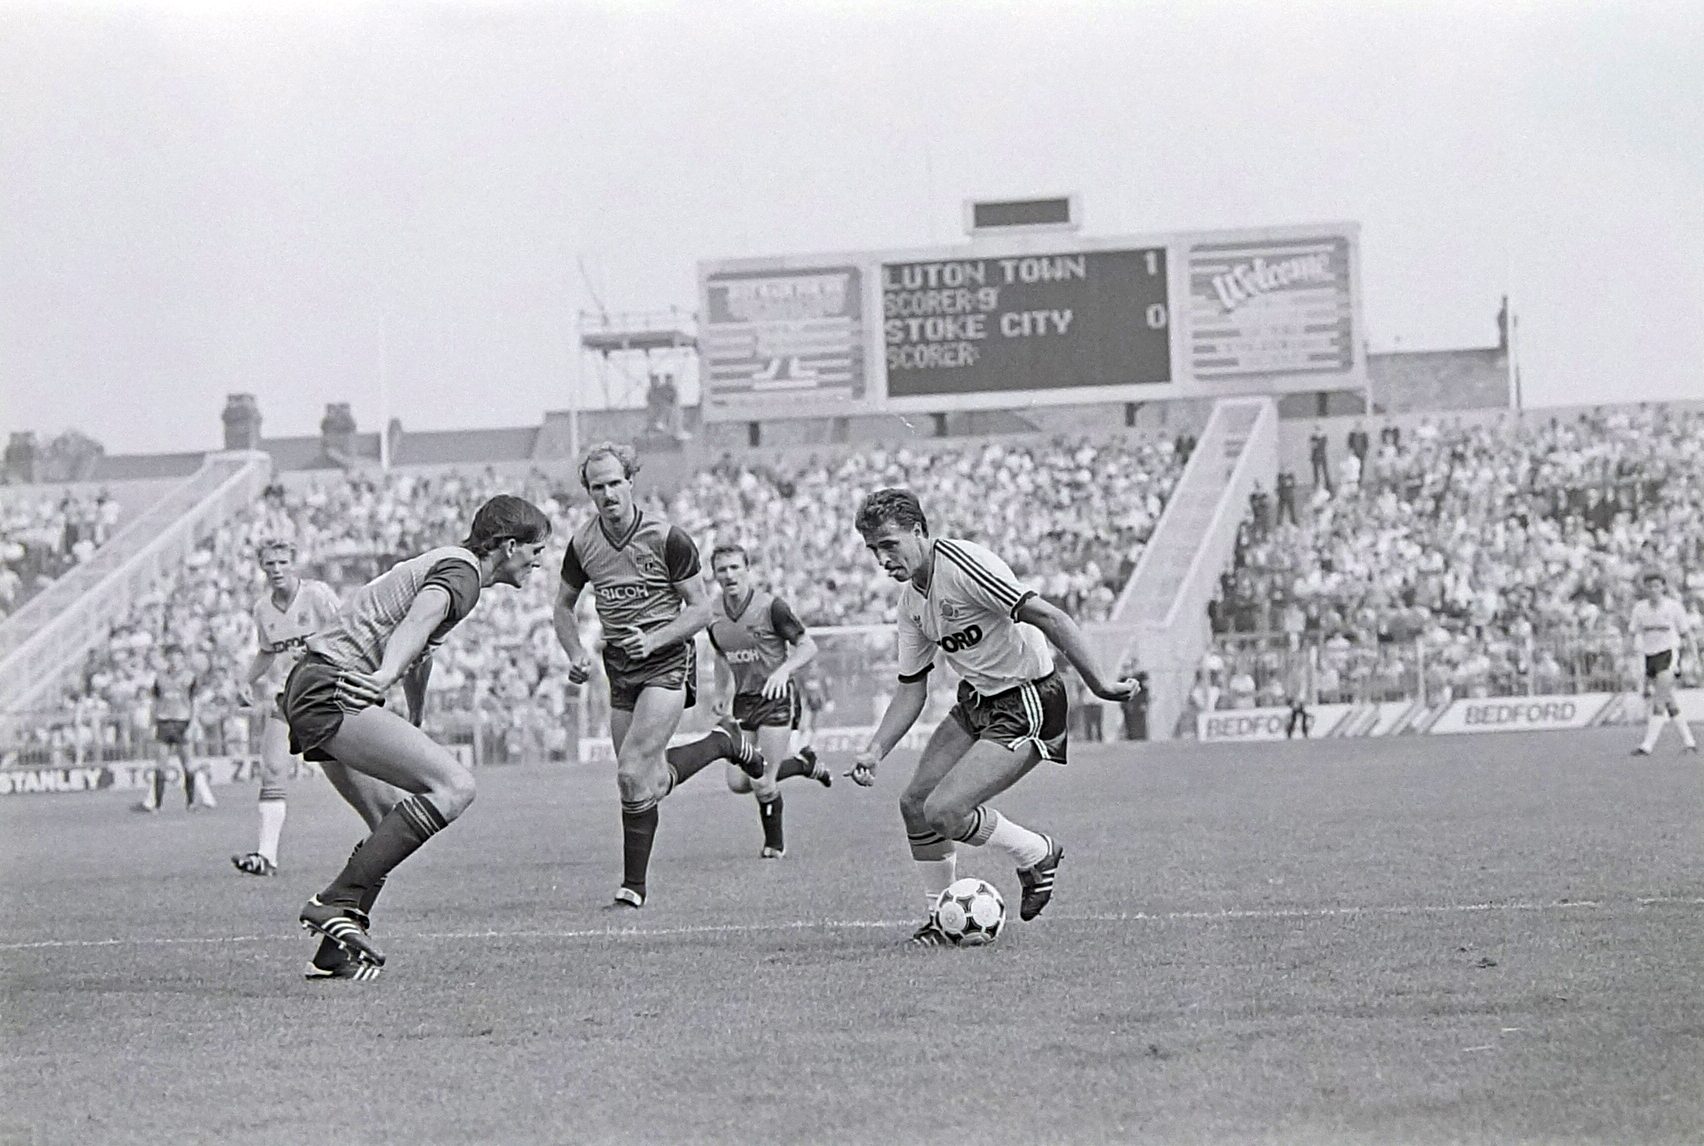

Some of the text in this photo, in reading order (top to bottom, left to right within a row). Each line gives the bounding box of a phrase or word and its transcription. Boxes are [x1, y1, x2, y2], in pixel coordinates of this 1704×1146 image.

[882, 250, 1158, 290] LUTON TOWN 1
[883, 303, 1167, 343] STOKE CITY 0
[1465, 702, 1576, 725] BEDFORD
[0, 767, 101, 795] STANLEY
